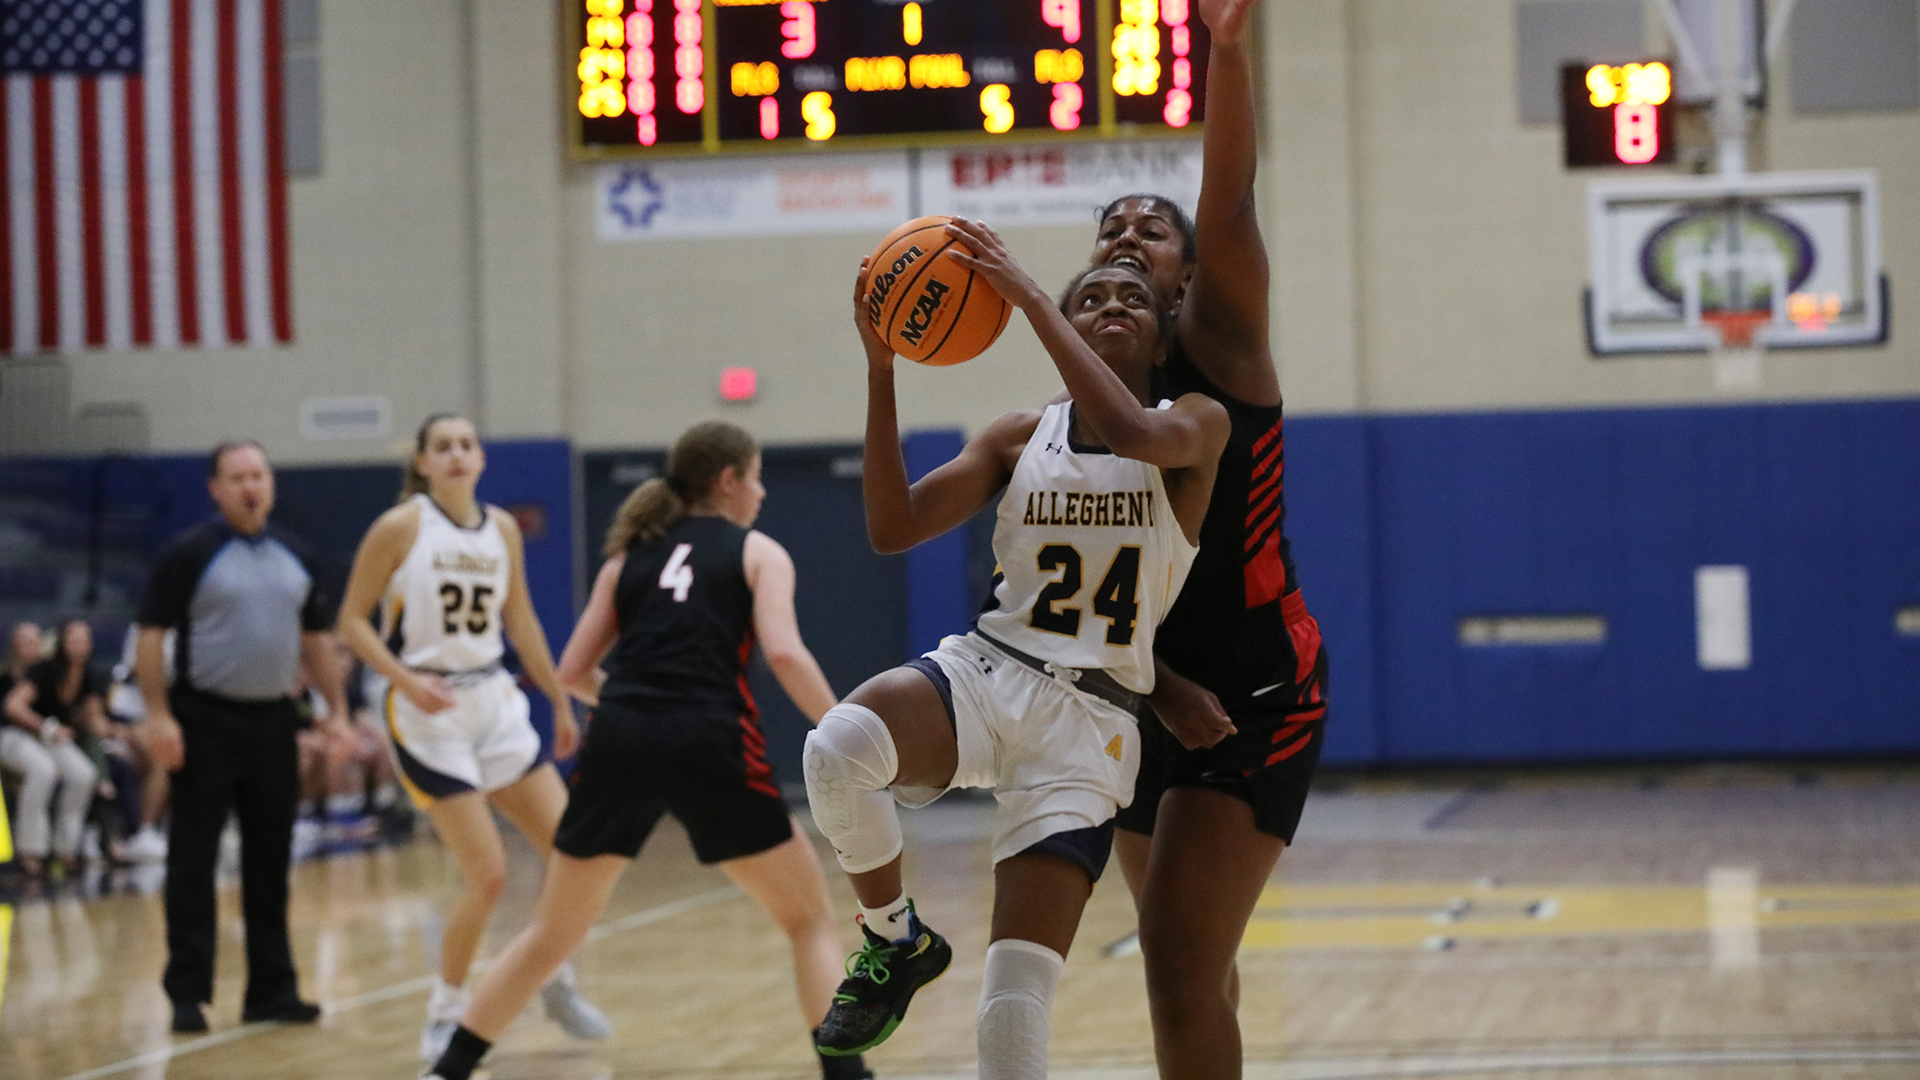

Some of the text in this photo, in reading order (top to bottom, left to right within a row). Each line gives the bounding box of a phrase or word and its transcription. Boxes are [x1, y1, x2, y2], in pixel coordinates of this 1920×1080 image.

[780, 0, 816, 59] 3
[903, 2, 922, 46] 1
[759, 96, 779, 140] 1
[801, 91, 836, 140] 5
[980, 84, 1015, 133] 5
[1050, 82, 1083, 131] 2
[899, 277, 950, 347] NCAA
[658, 543, 694, 602] 4
[1027, 542, 1143, 648] 24
[438, 582, 494, 635] 25
